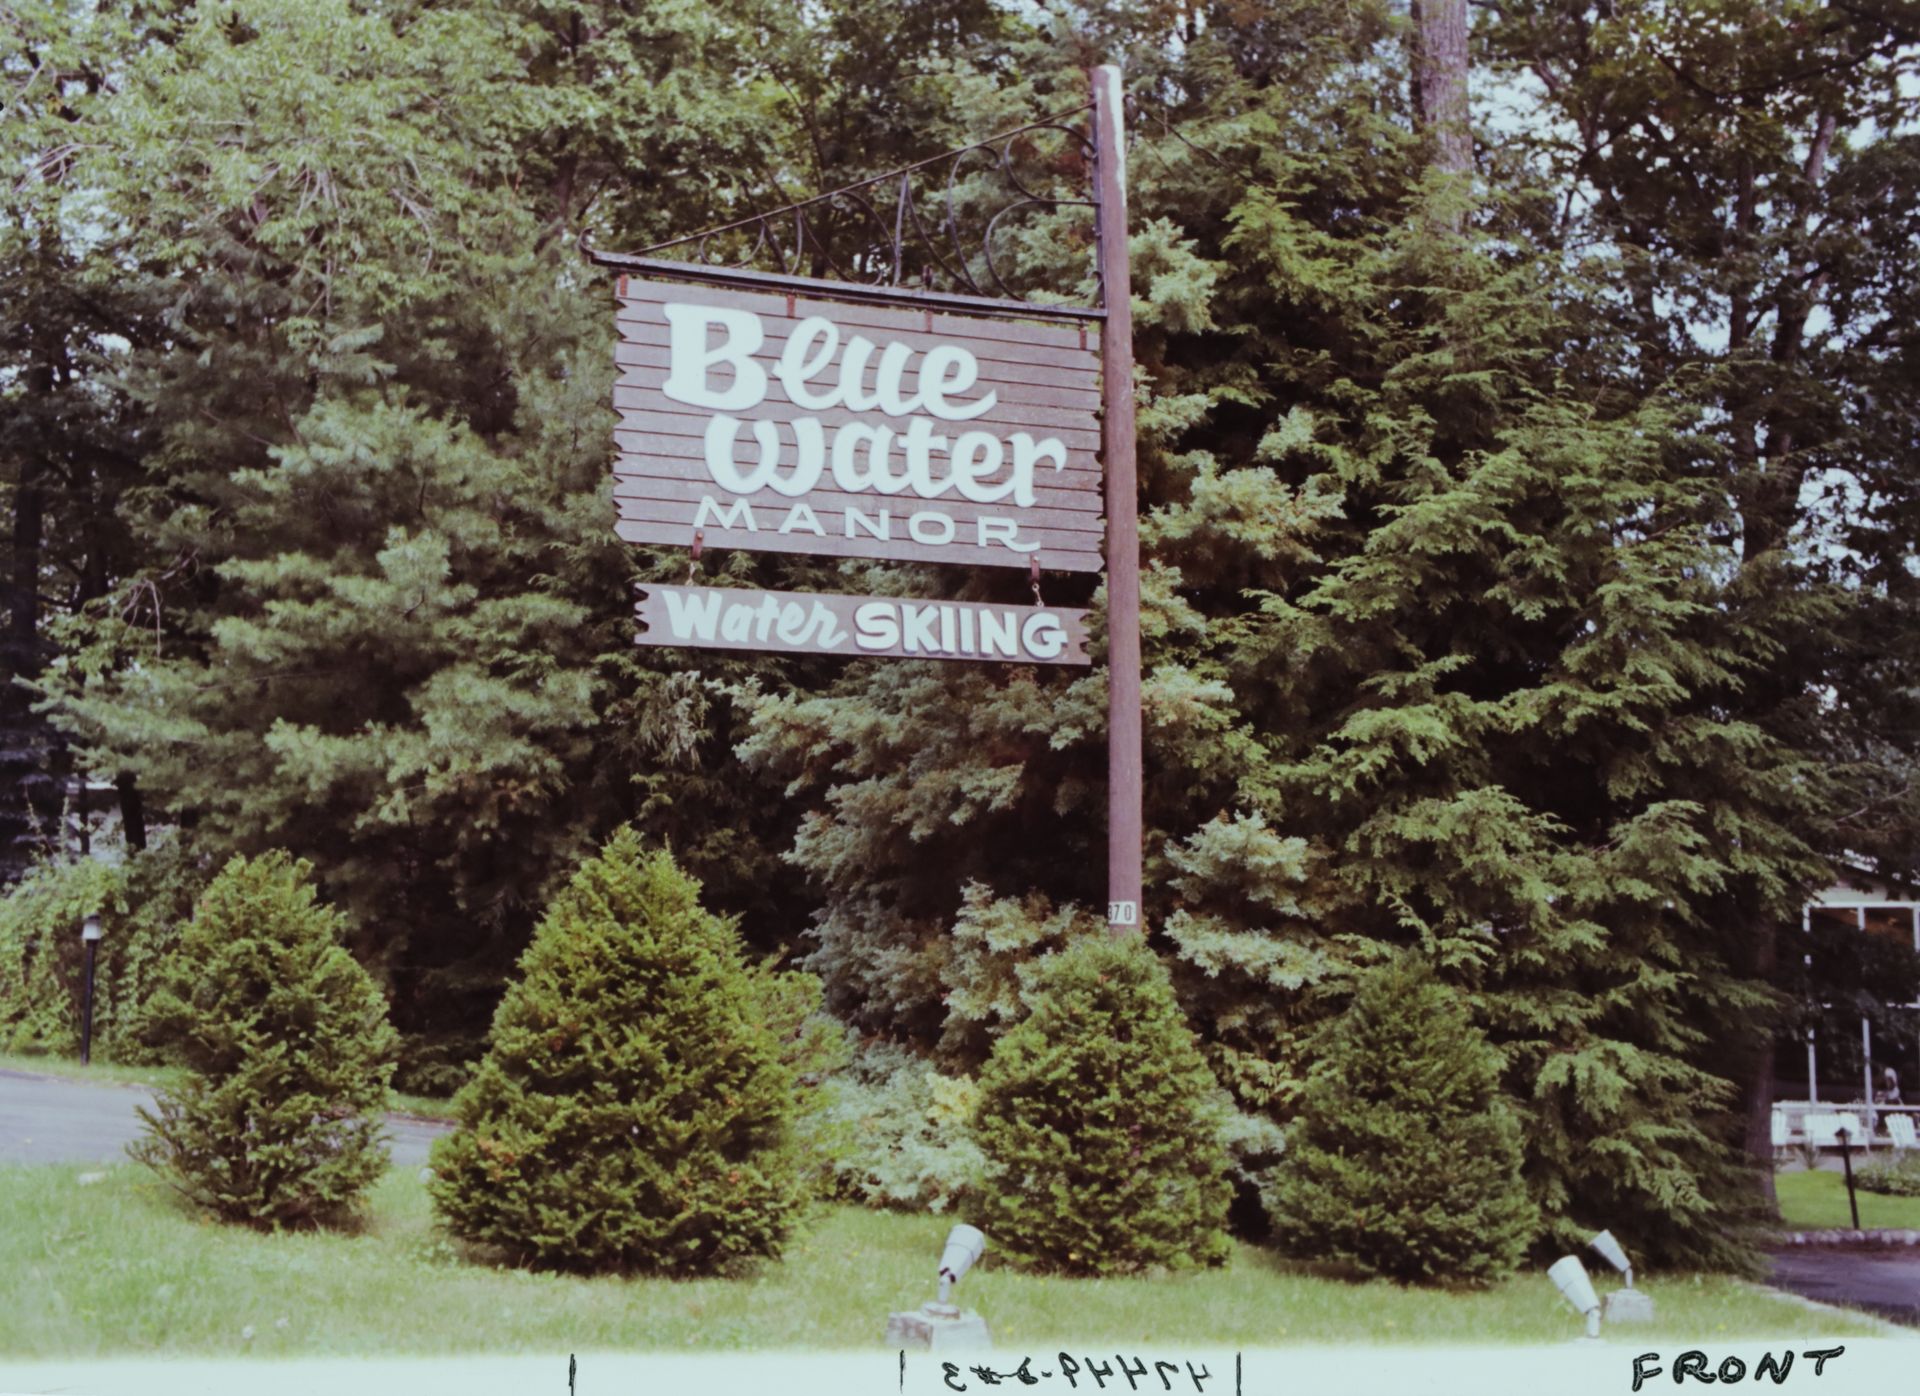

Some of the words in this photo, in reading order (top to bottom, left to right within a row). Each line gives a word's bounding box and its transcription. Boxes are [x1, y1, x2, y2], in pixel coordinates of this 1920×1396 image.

[664, 303, 997, 420] Blue
[704, 412, 1067, 508] Water
[693, 495, 1041, 553] MANOR
[662, 590, 848, 648] Water
[855, 602, 1068, 659] SKIING
[1631, 1345, 1846, 1392] FRONT
